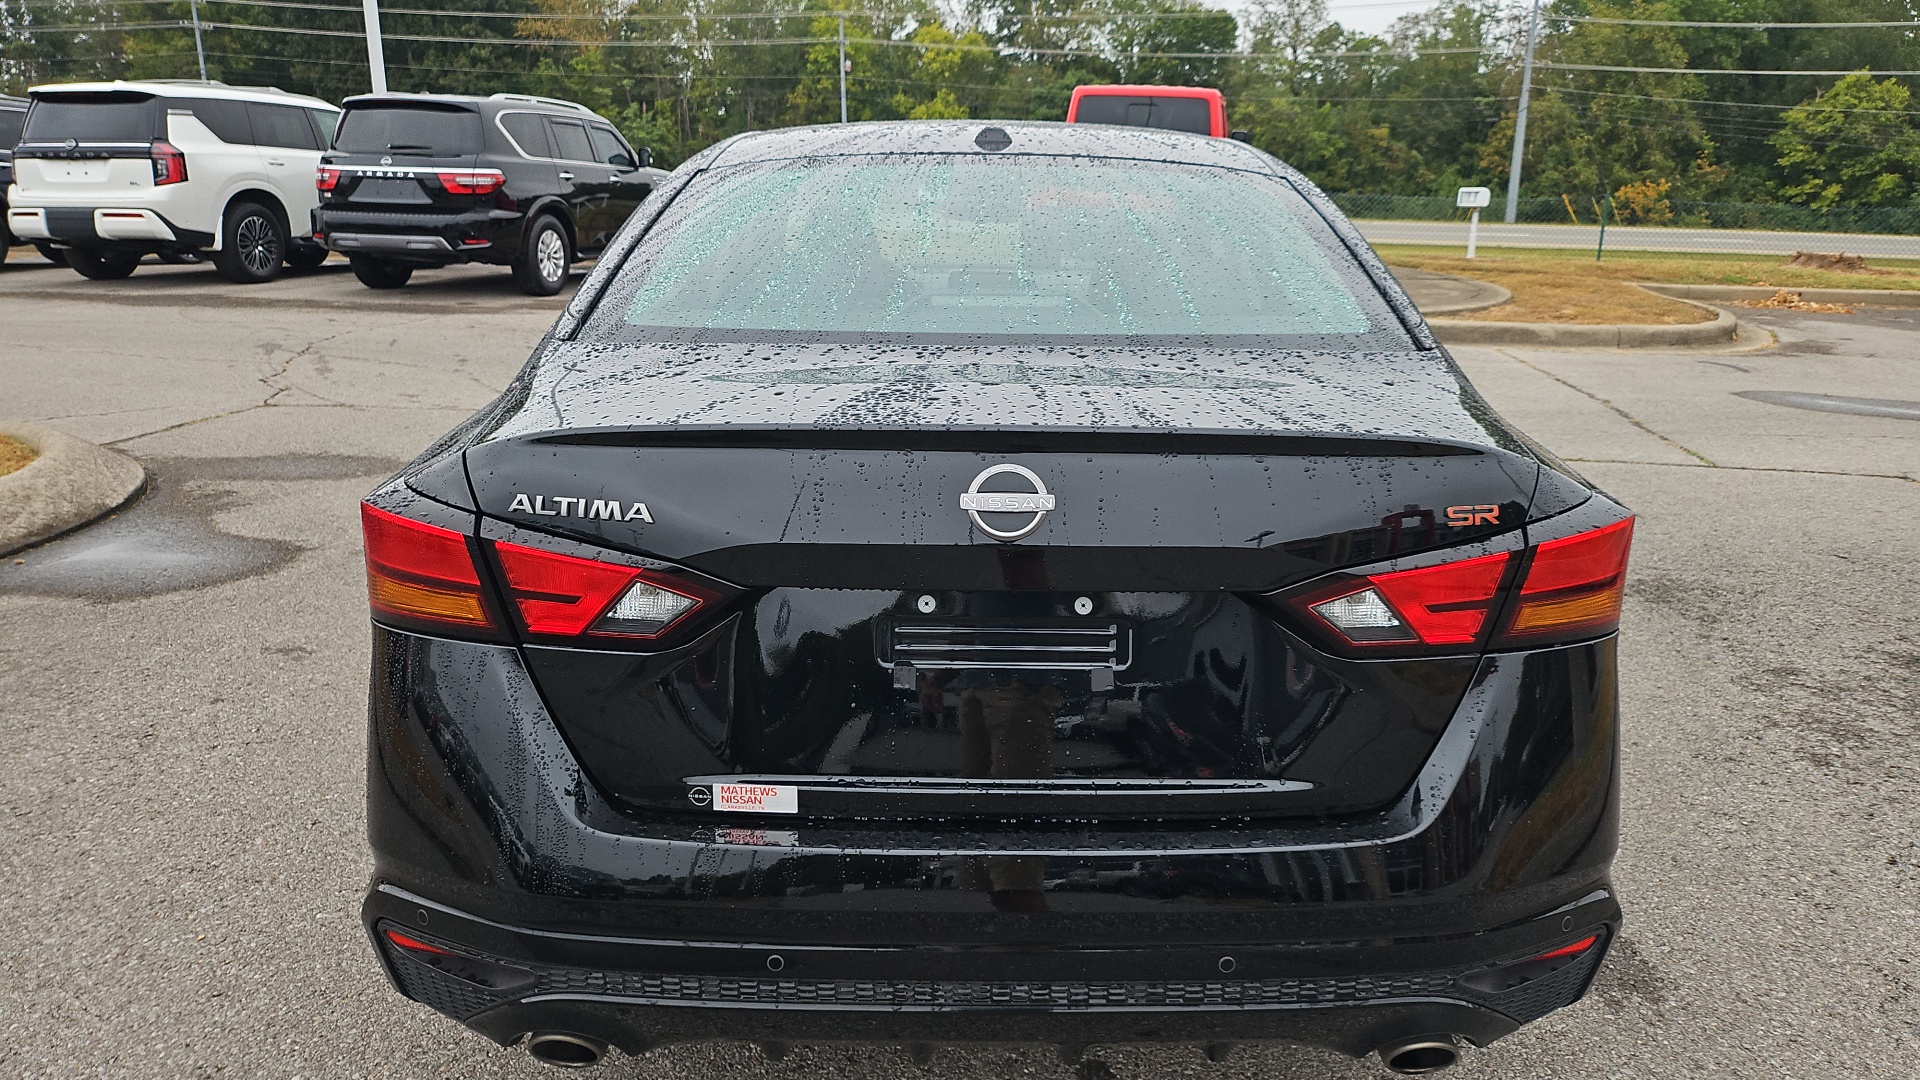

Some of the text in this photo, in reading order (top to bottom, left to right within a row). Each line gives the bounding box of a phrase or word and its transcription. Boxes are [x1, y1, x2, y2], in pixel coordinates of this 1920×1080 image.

[507, 493, 656, 524] ALTIMA
[963, 496, 1053, 509] NISSAN
[1446, 504, 1500, 527] SR
[721, 786, 777, 796] MATHEWS
[721, 795, 762, 804] NISSAN
